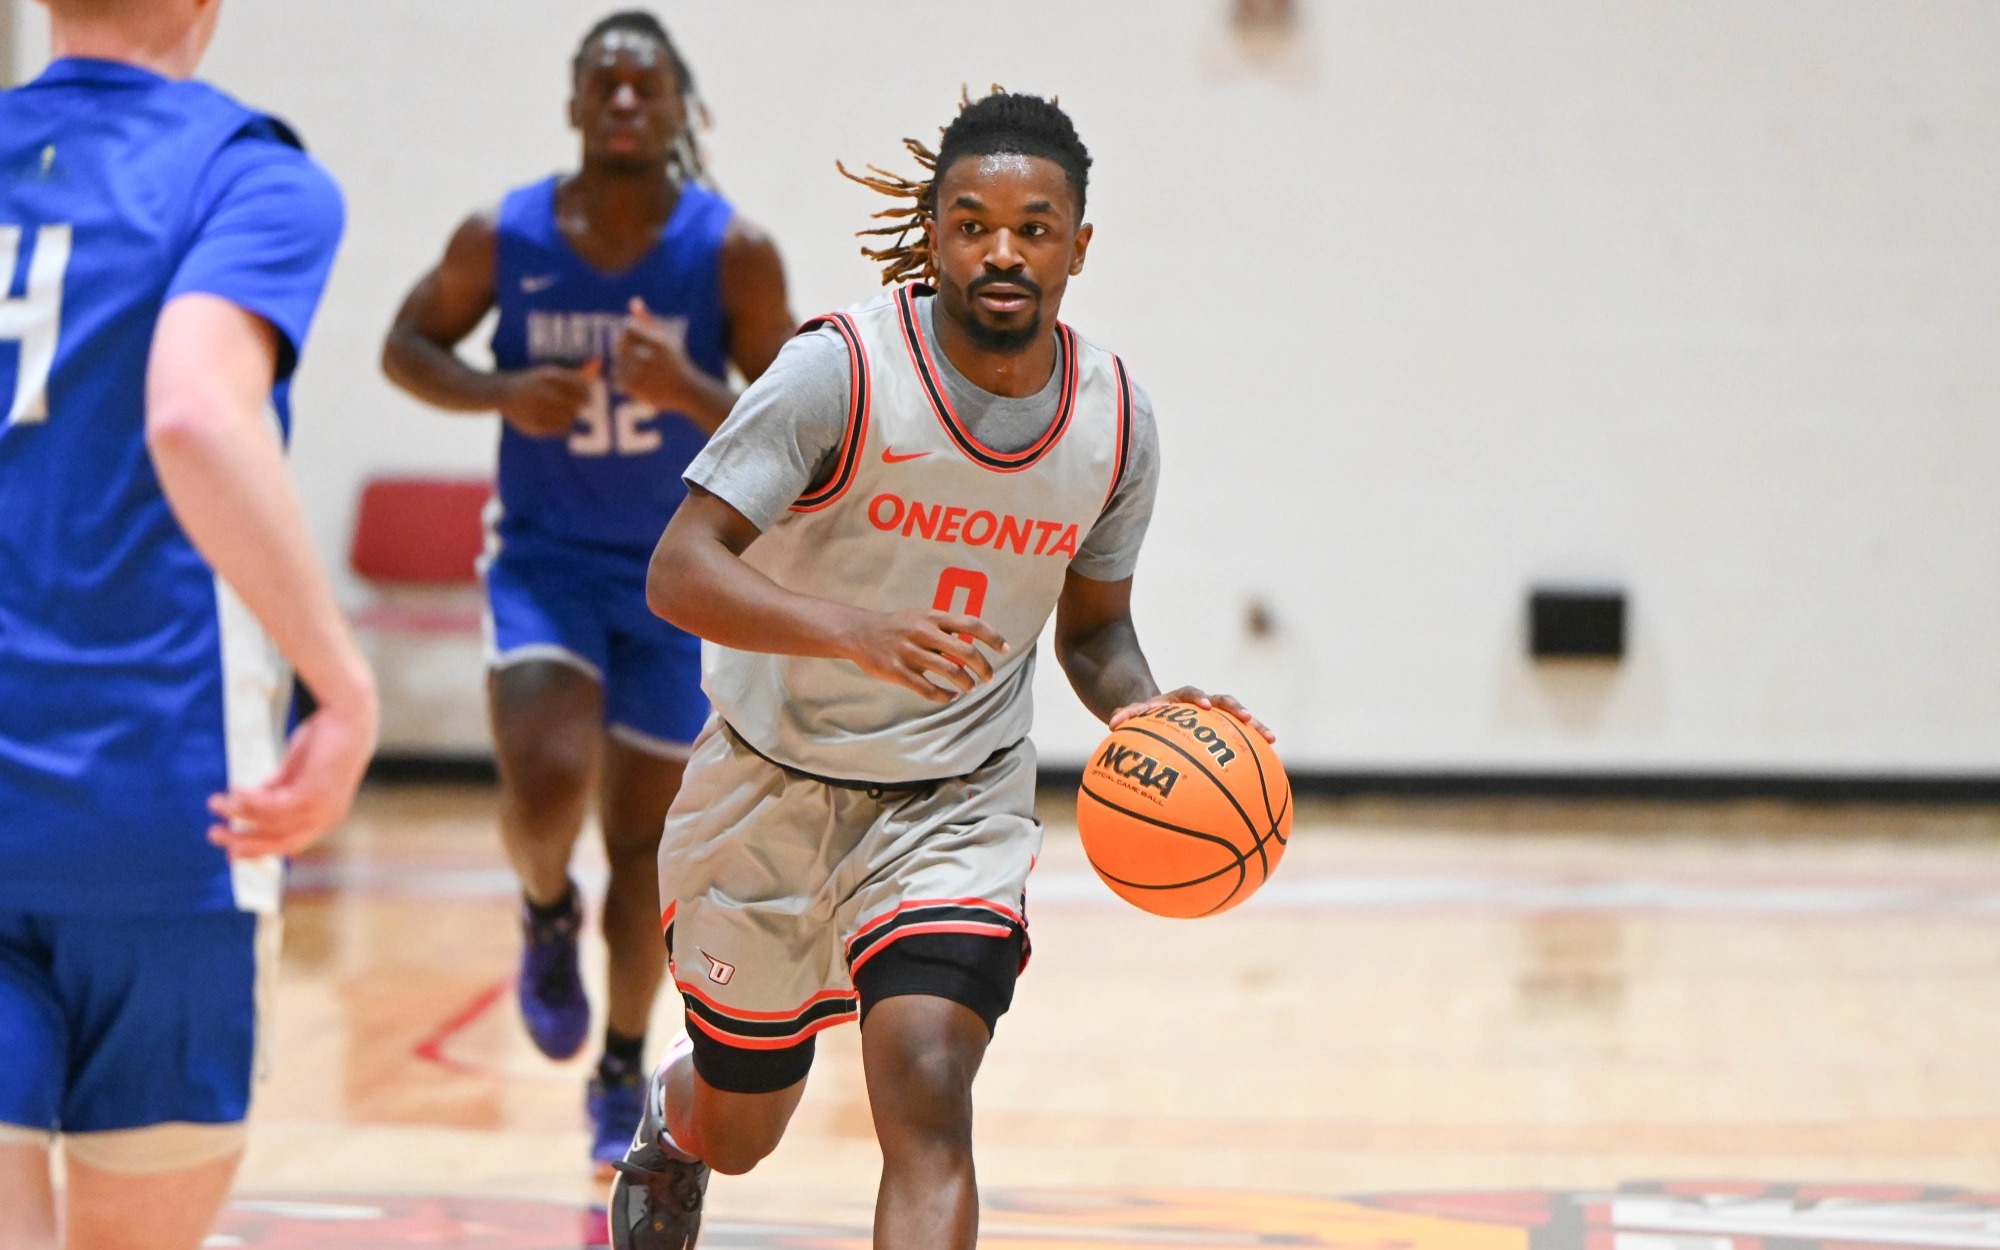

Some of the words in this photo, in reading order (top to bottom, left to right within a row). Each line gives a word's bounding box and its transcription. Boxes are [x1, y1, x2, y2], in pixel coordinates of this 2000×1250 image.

[867, 492, 1079, 560] ONEONTA
[1096, 741, 1180, 799] NCAA
[1116, 779, 1140, 794] GAME
[1140, 789, 1164, 807] BALL
